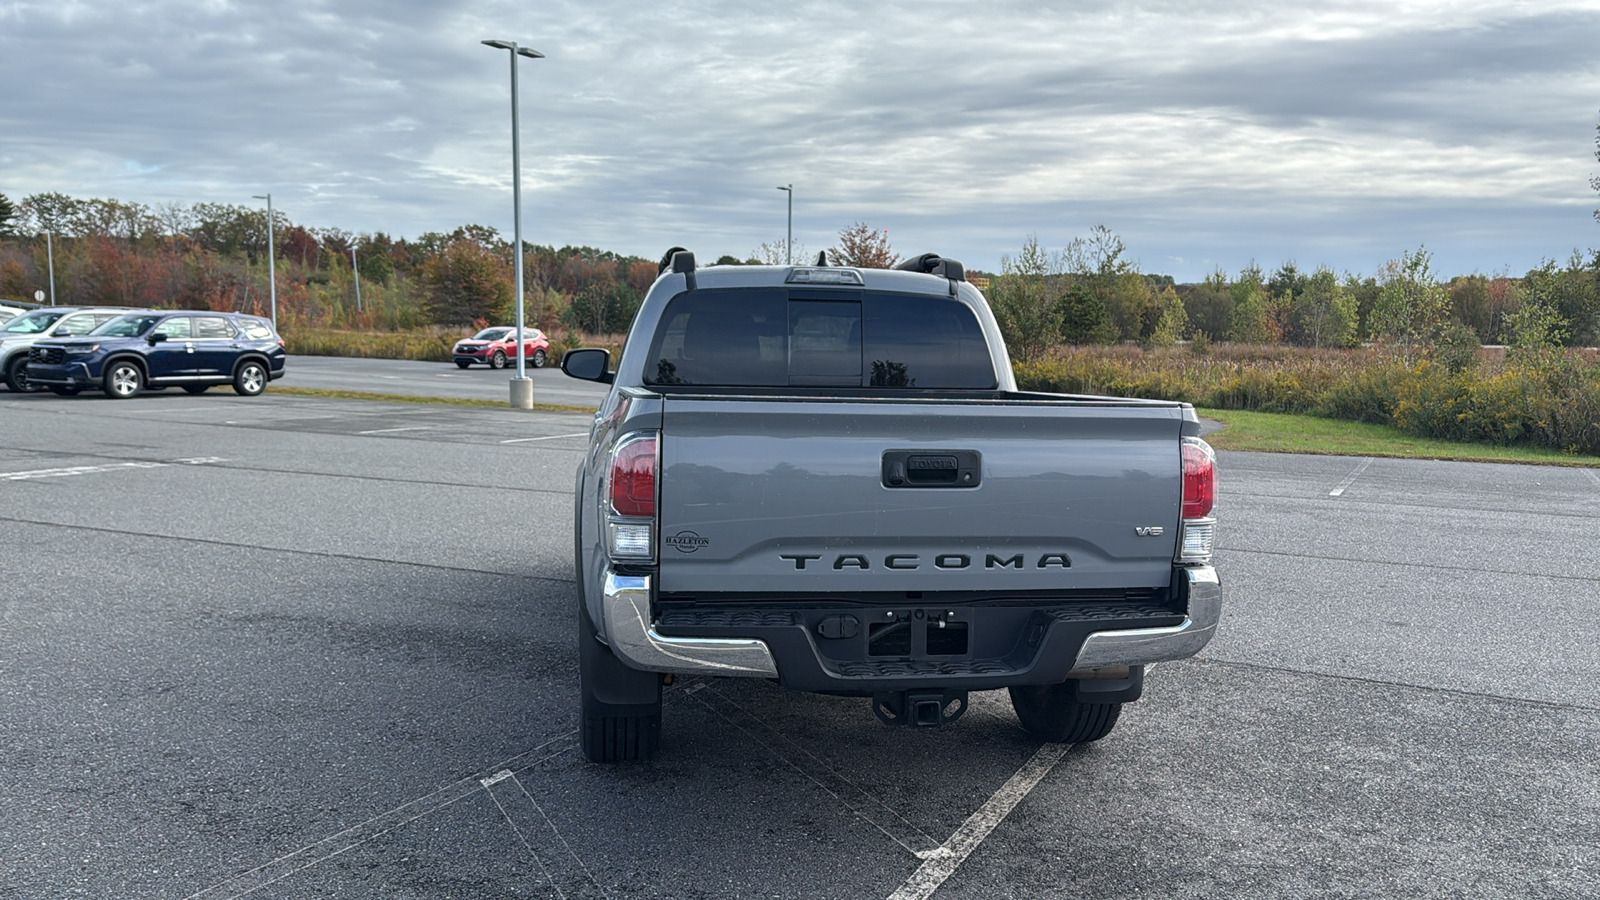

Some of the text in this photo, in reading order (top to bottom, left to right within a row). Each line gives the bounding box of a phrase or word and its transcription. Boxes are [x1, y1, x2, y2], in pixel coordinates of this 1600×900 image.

[912, 459, 955, 469] TOYOTA
[1135, 526, 1164, 537] V6
[666, 537, 709, 545] HAZLETON
[779, 553, 1072, 571] TACOMA
